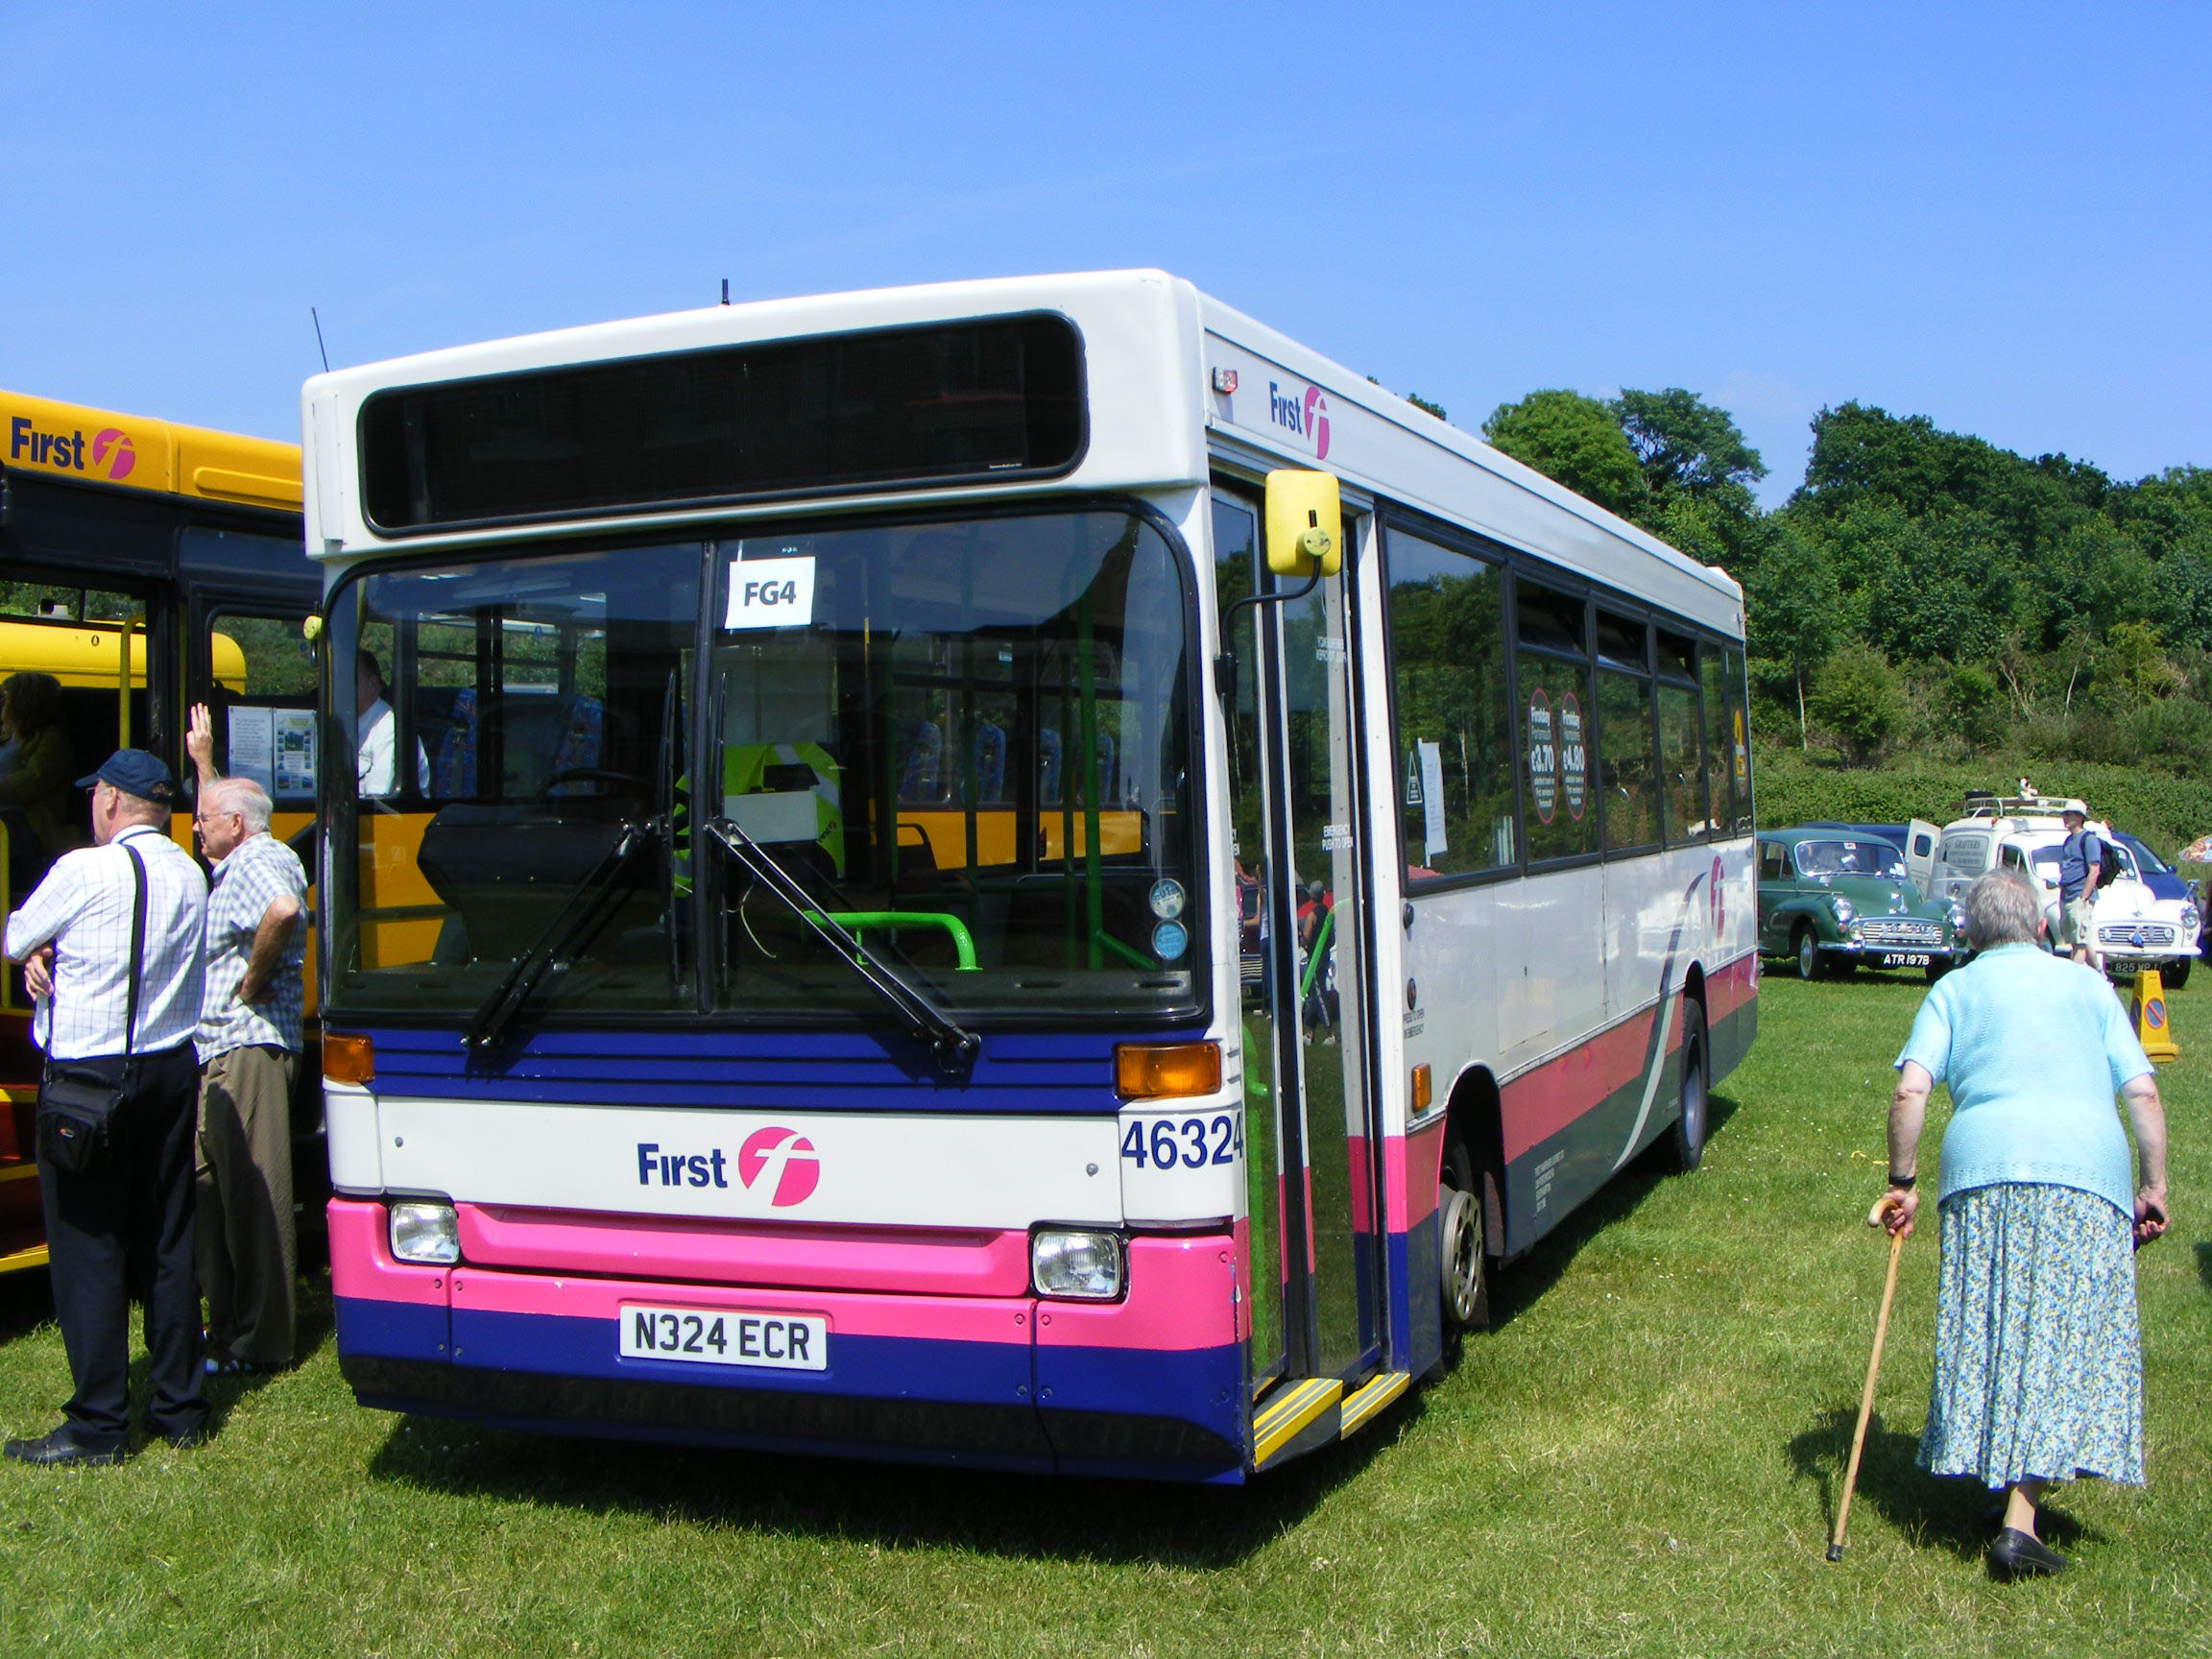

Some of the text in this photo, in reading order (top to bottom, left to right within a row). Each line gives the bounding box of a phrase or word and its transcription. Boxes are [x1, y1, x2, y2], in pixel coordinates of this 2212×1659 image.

[1269, 381, 1302, 435] First
[11, 416, 84, 470] First
[744, 581, 797, 607] FG4
[1884, 953, 1930, 966] ATR 197B
[2115, 962, 2135, 973] 825
[1121, 1112, 1243, 1169] 46324
[637, 1142, 728, 1189] First
[636, 1312, 809, 1360] N324 ECR
